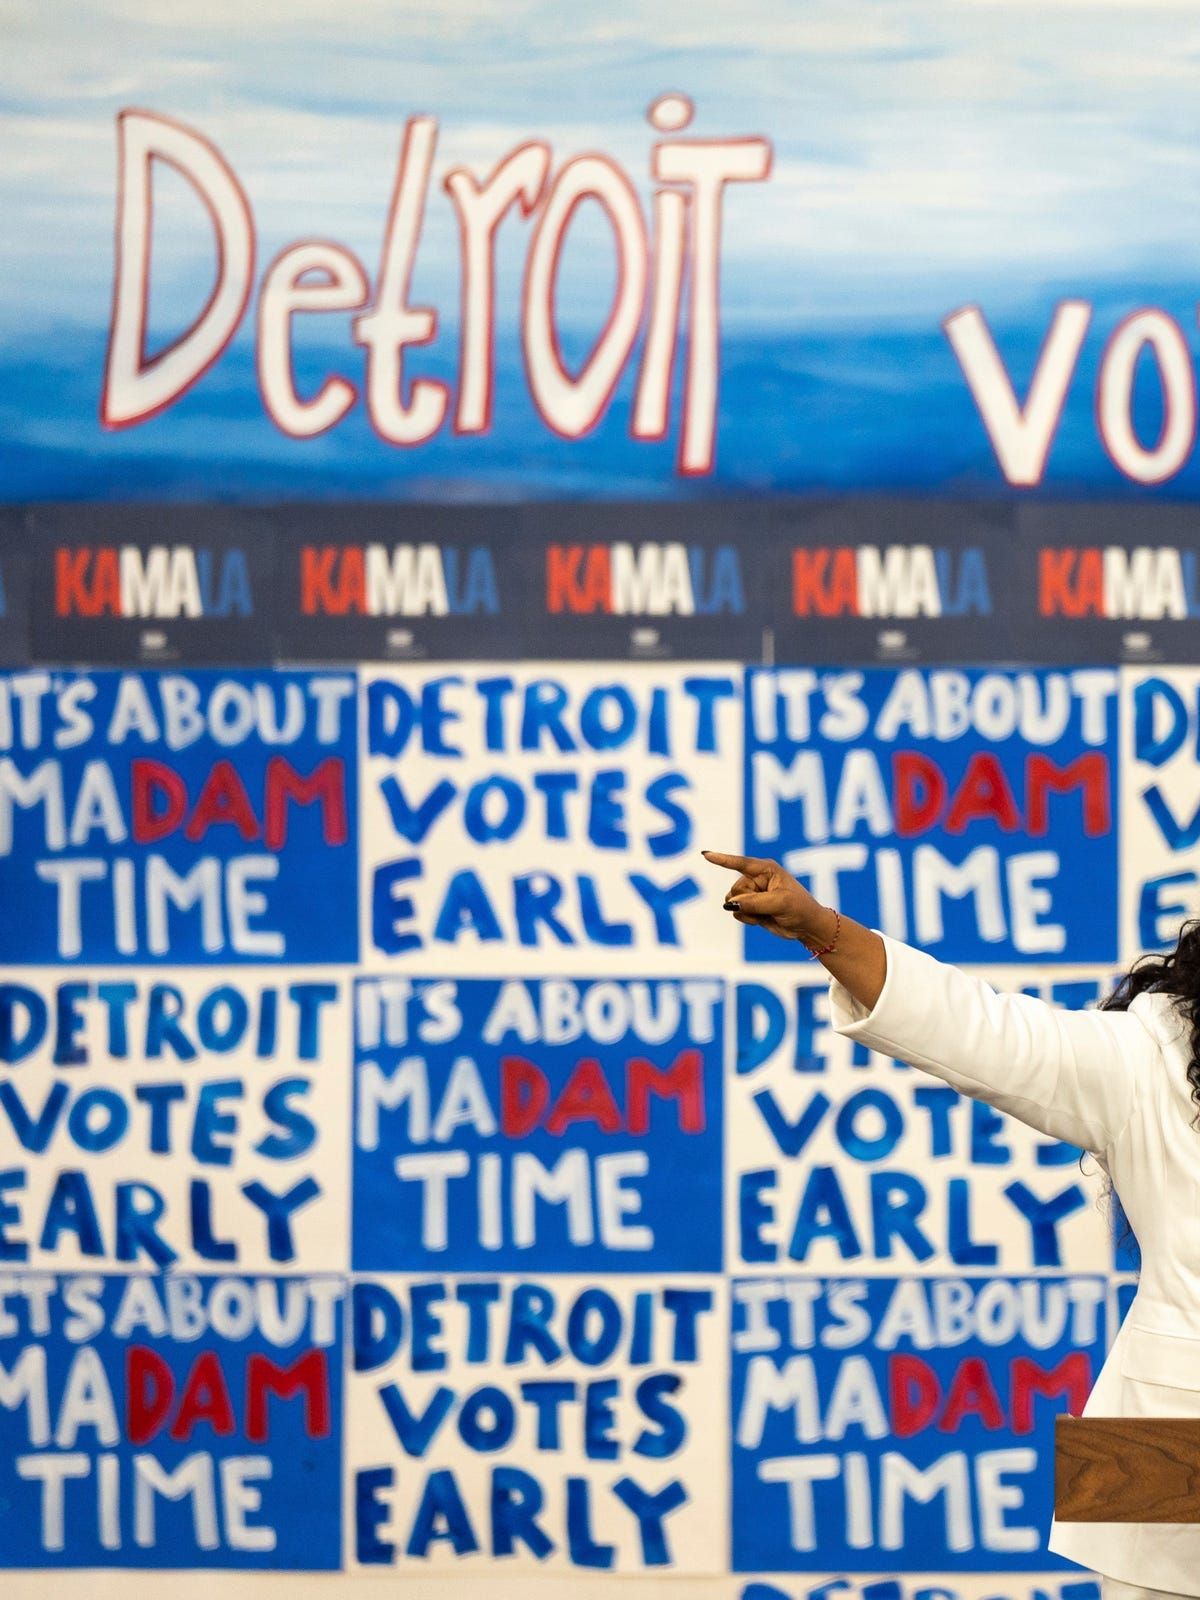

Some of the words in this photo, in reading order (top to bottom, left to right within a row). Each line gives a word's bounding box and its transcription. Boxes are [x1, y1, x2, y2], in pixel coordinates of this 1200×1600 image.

[55, 543, 253, 618] KAMALA
[302, 542, 499, 617] KAMALA
[547, 541, 746, 616] KAMALA
[793, 544, 992, 618] KAMALA
[107, 674, 354, 752] ABOUT
[366, 676, 735, 759] DETROIT
[873, 669, 1119, 746] ABOUT
[0, 756, 348, 856] MADAM
[379, 769, 693, 858] VOTES
[752, 747, 1112, 844] MADAM
[34, 853, 286, 958] TIME
[371, 857, 702, 956] EARLY
[783, 842, 1067, 955] TIME
[0, 980, 338, 1066] DETROIT
[481, 978, 722, 1045] ABOUT
[0, 1078, 318, 1166] VOTES
[355, 1047, 706, 1151] MADAM
[752, 1085, 1085, 1168] VOTE
[394, 1147, 654, 1252] TIME
[737, 1166, 1087, 1267] EARLY
[112, 1275, 347, 1348] ABOUT
[352, 1282, 713, 1373] DETROIT
[873, 1278, 1104, 1351] ABOUT
[377, 1372, 687, 1460] VOTES
[736, 1351, 1092, 1450] MADAM
[15, 1450, 277, 1552] TIME
[354, 1465, 688, 1572] EARLY
[757, 1446, 1040, 1554] TIME
